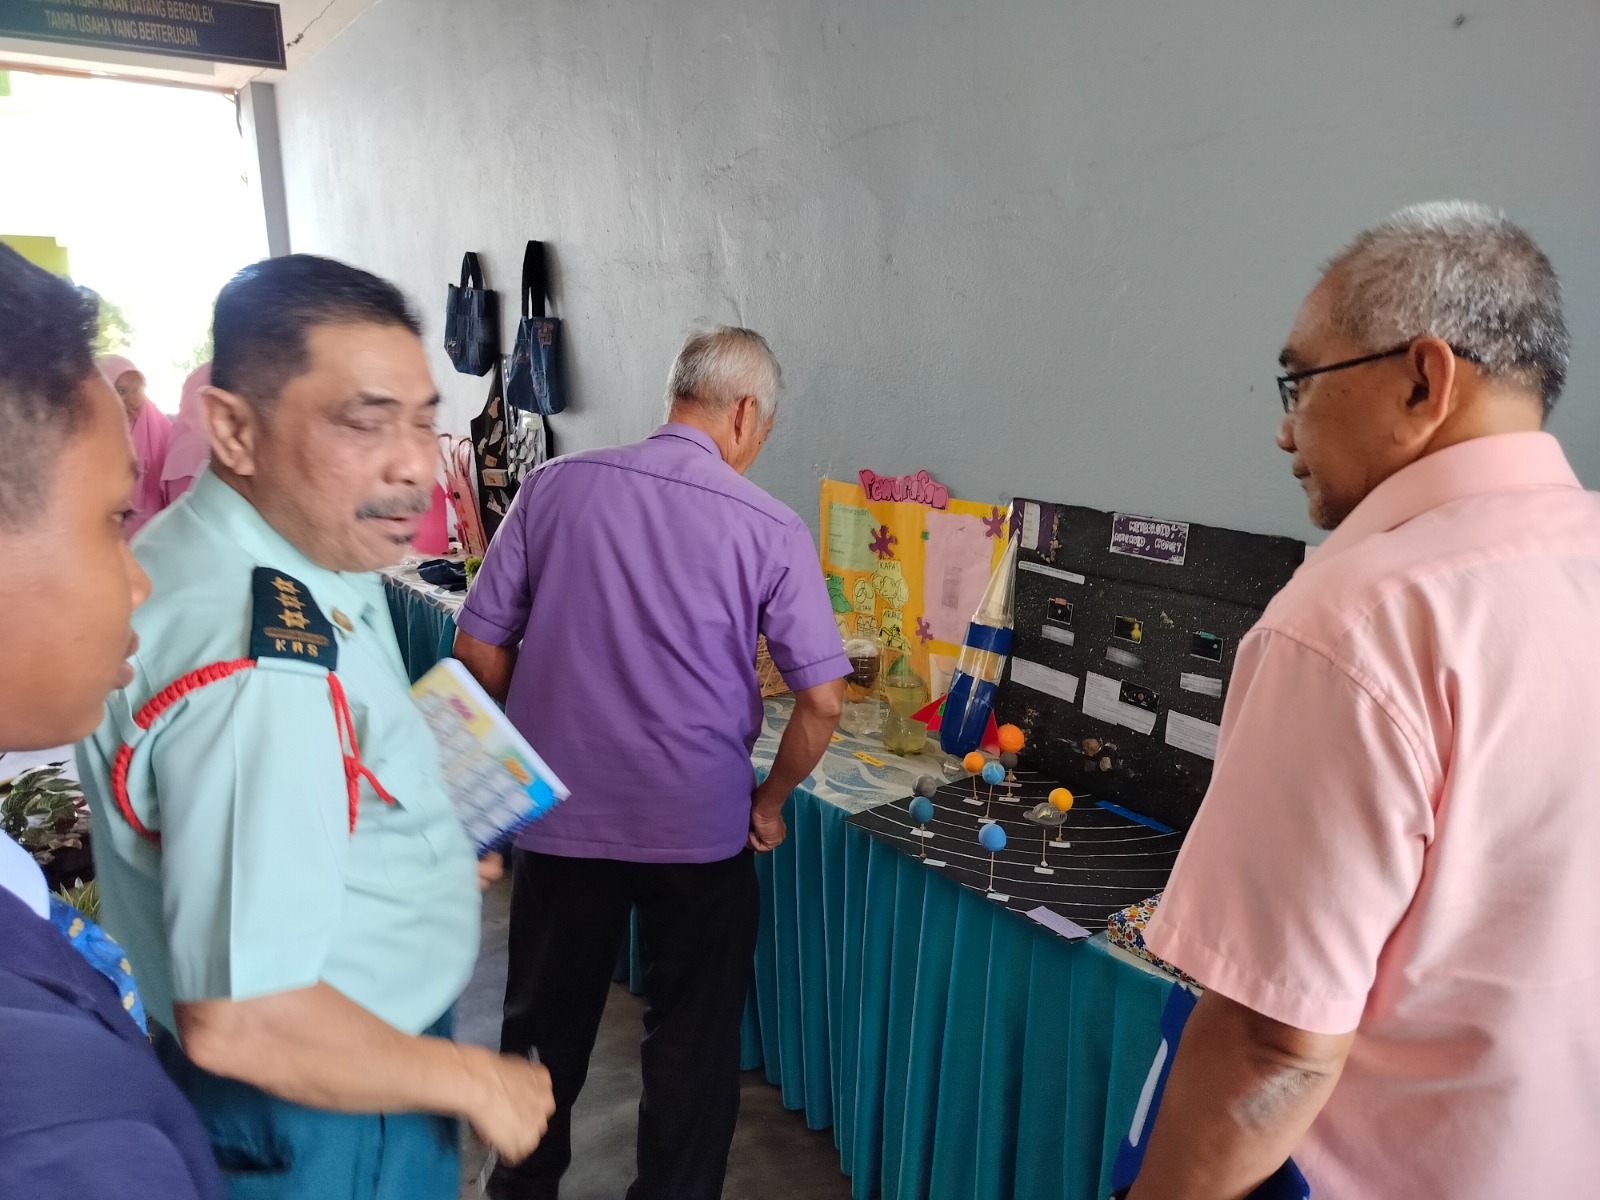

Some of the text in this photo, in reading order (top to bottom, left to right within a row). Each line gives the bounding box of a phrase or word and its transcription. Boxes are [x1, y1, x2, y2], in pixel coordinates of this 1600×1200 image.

[44, 9, 77, 31] TANPA
[77, 13, 112, 35] USAHA
[111, 18, 138, 39] YANG
[167, 1, 215, 24] BERGOLEK
